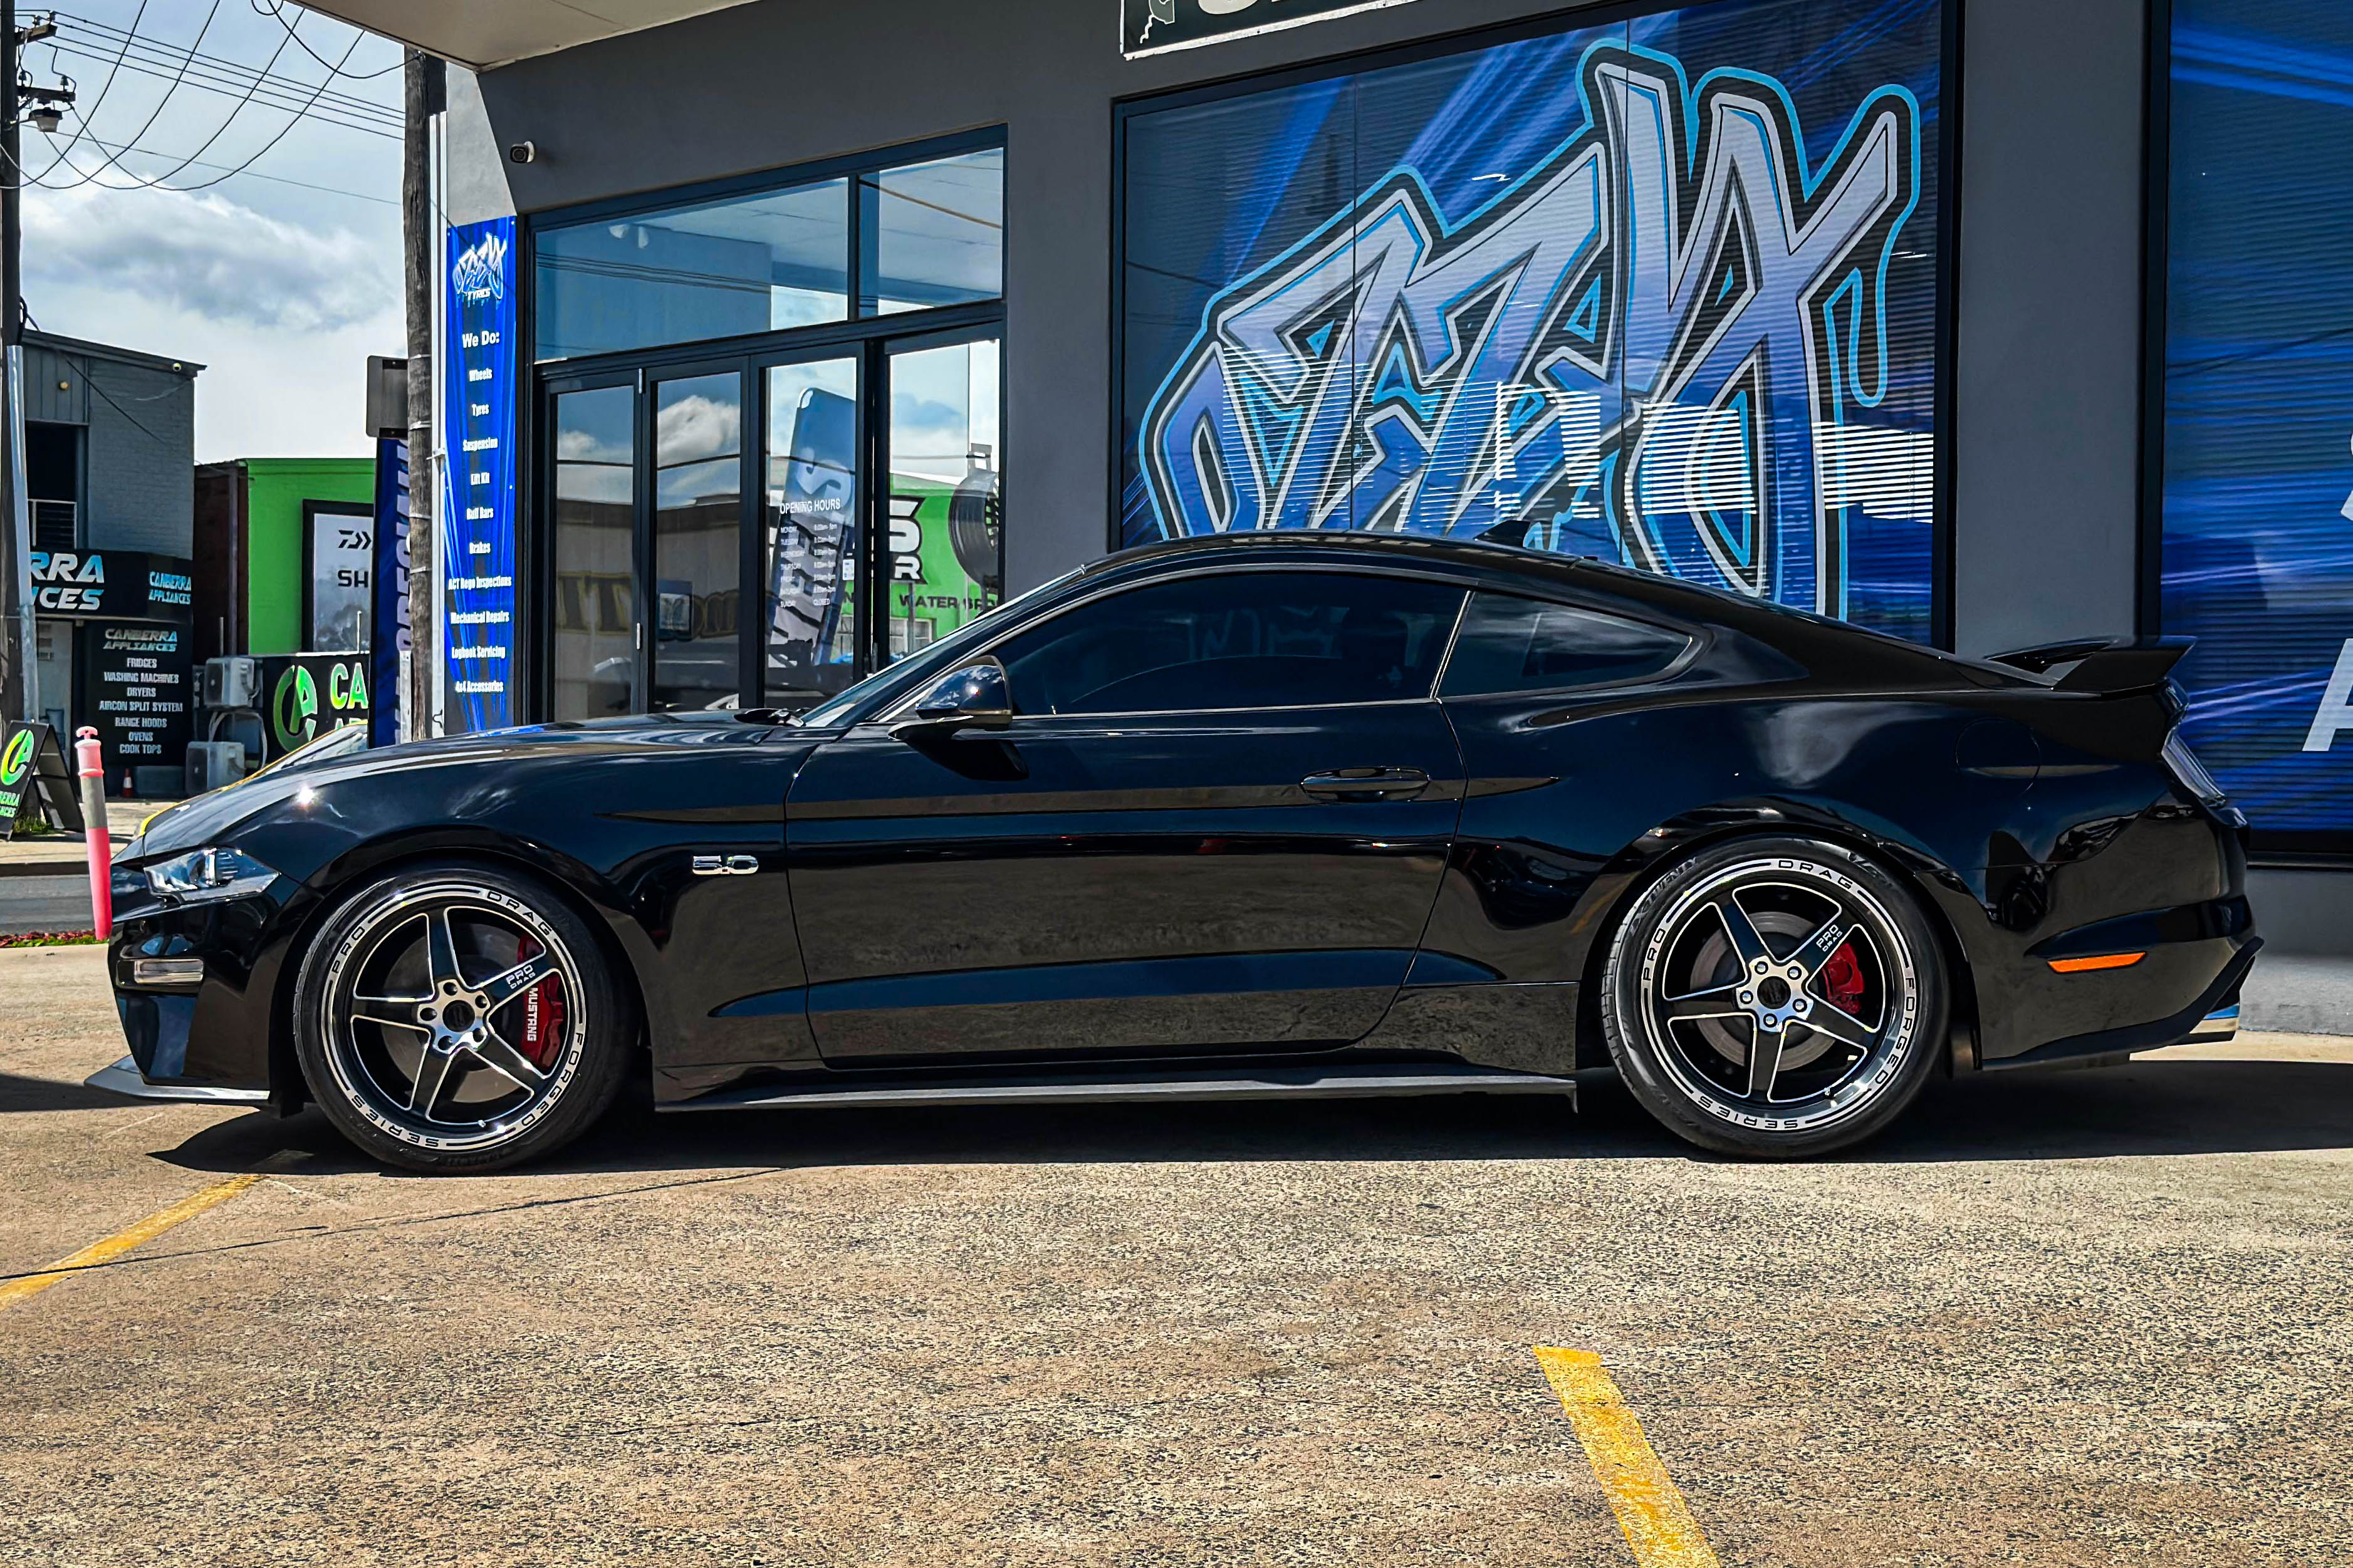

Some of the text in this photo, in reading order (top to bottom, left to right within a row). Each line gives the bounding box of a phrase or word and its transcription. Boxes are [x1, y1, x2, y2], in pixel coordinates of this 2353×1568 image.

[462, 331, 500, 348] We Do:
[469, 368, 493, 382] Wheels
[471, 404, 489, 417] Tyres
[463, 437, 498, 452] Suspension
[479, 507, 494, 519] Bars
[780, 497, 841, 514] OPENING HOURS
[469, 541, 491, 554] Brakes
[149, 571, 192, 591] CANBERRA
[448, 575, 512, 590] ACT Rego Inspections
[149, 589, 191, 605] APPLIANCES
[451, 610, 509, 624] Mechanical Repairs
[105, 628, 178, 642] CANBERRA
[103, 641, 178, 652] APPLIANCES
[452, 645, 506, 659] Logbook Servicing
[127, 658, 157, 668] FRIDGES
[104, 672, 179, 684] WASHING MACHINES
[127, 687, 156, 697] DRYERS
[467, 680, 504, 692] Accessories
[99, 700, 183, 712] AIRCON SPLIT SYSTEM
[115, 717, 167, 728] RANGE HOODS
[128, 731, 154, 742] OVENS
[120, 744, 162, 754] COOK TOPS
[692, 855, 759, 875] 5.0
[1778, 859, 1853, 890] DRAG
[487, 891, 552, 935] DRAG
[1815, 924, 1839, 948] PRO
[1822, 930, 1843, 952] DRAG
[331, 927, 365, 974] PRO
[1642, 927, 1666, 981] PRO
[506, 964, 533, 985] PRO
[527, 987, 538, 1042] MUSTANG
[1874, 976, 1916, 1084] FORGED
[521, 1033, 583, 1126] FORGED
[1698, 1096, 1799, 1129] SERIES
[350, 1094, 439, 1148] SERIES
